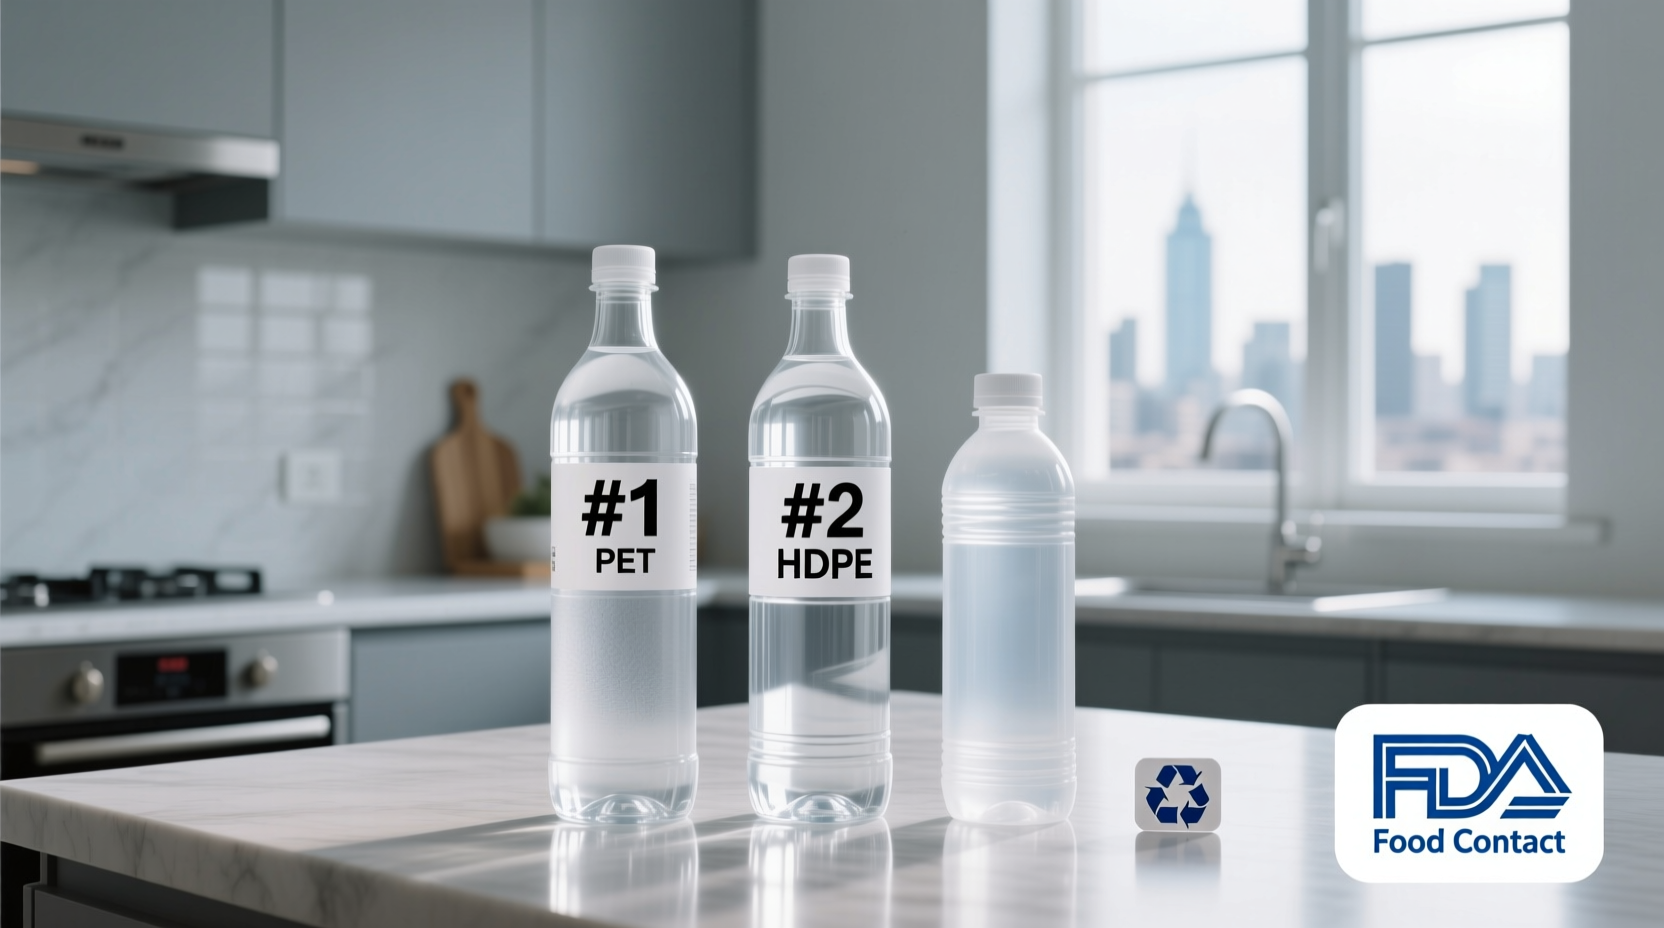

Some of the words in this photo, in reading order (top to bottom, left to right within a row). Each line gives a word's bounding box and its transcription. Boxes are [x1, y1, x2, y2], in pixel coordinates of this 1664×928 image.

[581, 478, 658, 537] #1
[781, 481, 864, 539] #2
[596, 547, 656, 574] PET
[777, 548, 873, 579] HDPE
